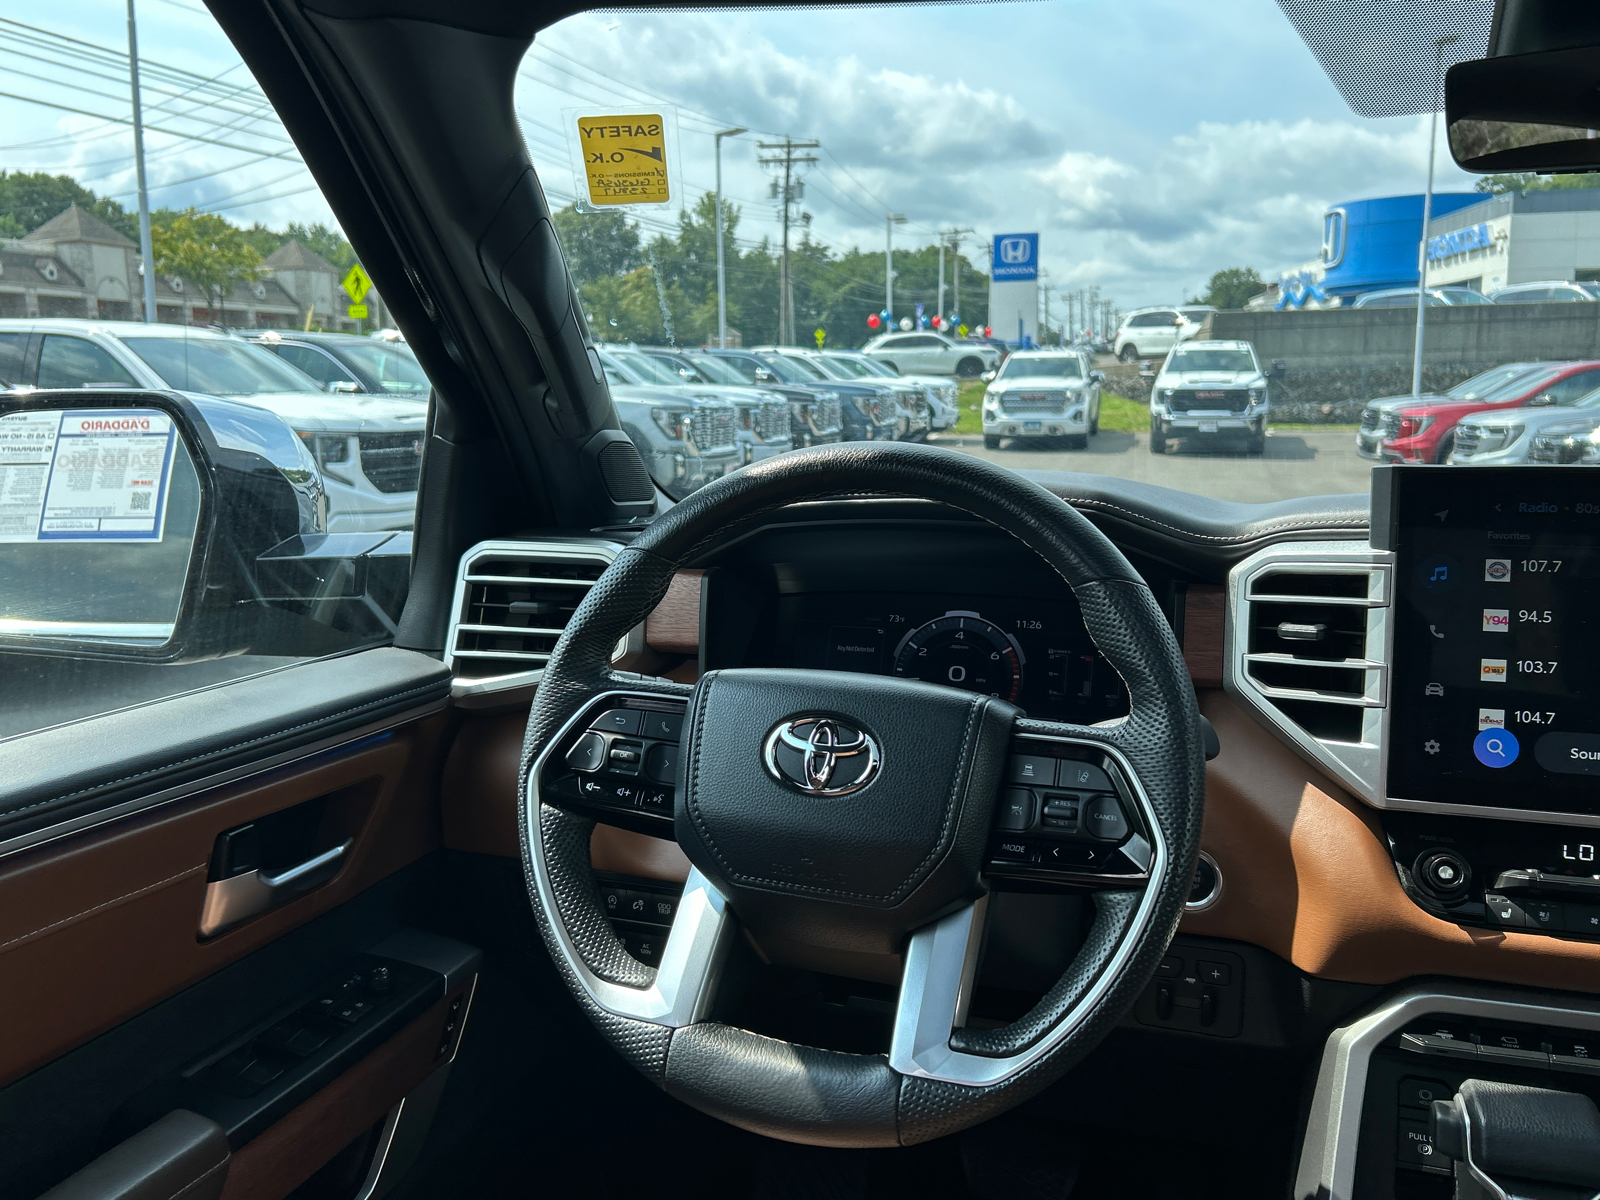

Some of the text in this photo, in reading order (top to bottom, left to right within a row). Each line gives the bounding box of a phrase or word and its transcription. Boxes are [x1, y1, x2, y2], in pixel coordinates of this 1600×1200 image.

[1519, 502, 1600, 514] Radio 80s
[1487, 531, 1531, 540] Favorites
[1521, 560, 1562, 573] 107.7
[1484, 615, 1509, 626] Y94
[1518, 610, 1552, 623] 94.5
[1015, 620, 1042, 630] 11:26
[955, 631, 965, 640] 4
[855, 645, 875, 653] Detected
[918, 648, 927, 656] 2
[990, 651, 1000, 660] 6
[1516, 660, 1558, 674] 103.7
[948, 665, 966, 682] 0
[1514, 710, 1556, 725] 104.7
[1094, 813, 1118, 821] CANCEL
[1002, 843, 1026, 853] MODE
[1563, 844, 1594, 861] LO
[1408, 1131, 1427, 1142] PULL
